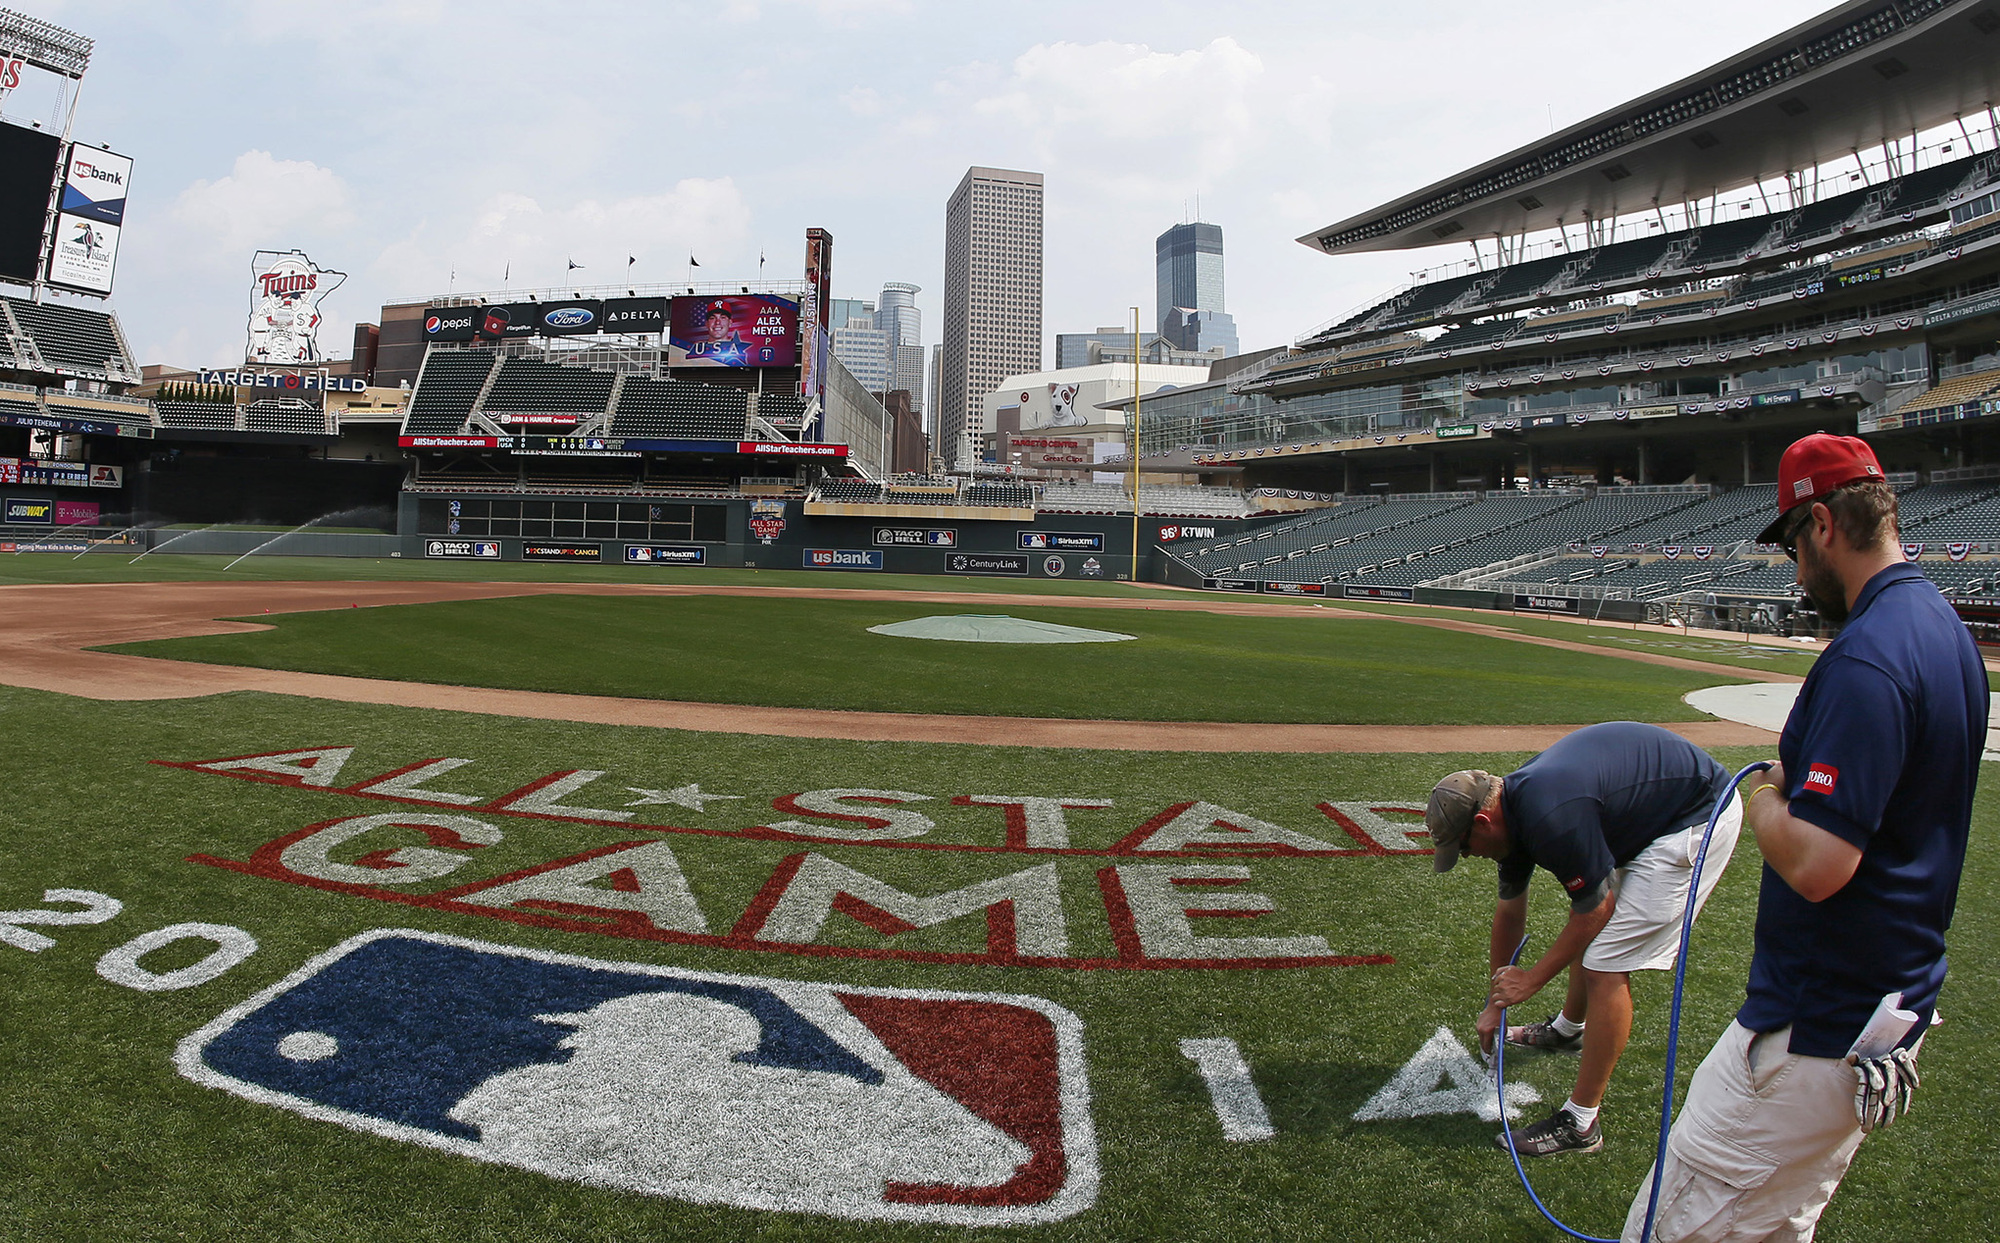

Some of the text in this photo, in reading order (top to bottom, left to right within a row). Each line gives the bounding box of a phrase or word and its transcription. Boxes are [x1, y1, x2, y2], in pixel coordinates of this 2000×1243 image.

[74, 161, 122, 186] usbank
[61, 241, 110, 263] Treasure Island
[258, 270, 317, 298] Twins
[621, 310, 661, 321] DELTA
[760, 307, 780, 315] AAA
[554, 310, 583, 325] Ford
[757, 317, 782, 326] ALEX
[1931, 312, 1951, 323] DELTA
[441, 316, 472, 333] pepsi
[752, 327, 786, 335] MEYER
[199, 370, 368, 393] TARGET FIELD
[34, 419, 61, 428] TEHERAN
[413, 437, 486, 446] AllStarTeachers.com
[755, 444, 835, 455] AllStarTeachers.com
[1043, 454, 1083, 463] Great Clips
[8, 505, 49, 517] SUBWAY
[757, 526, 777, 534] GAME
[812, 551, 872, 564] usbank
[969, 559, 1019, 570] CenturyLink
[180, 745, 636, 823] ALL
[265, 811, 1338, 961] GAME
